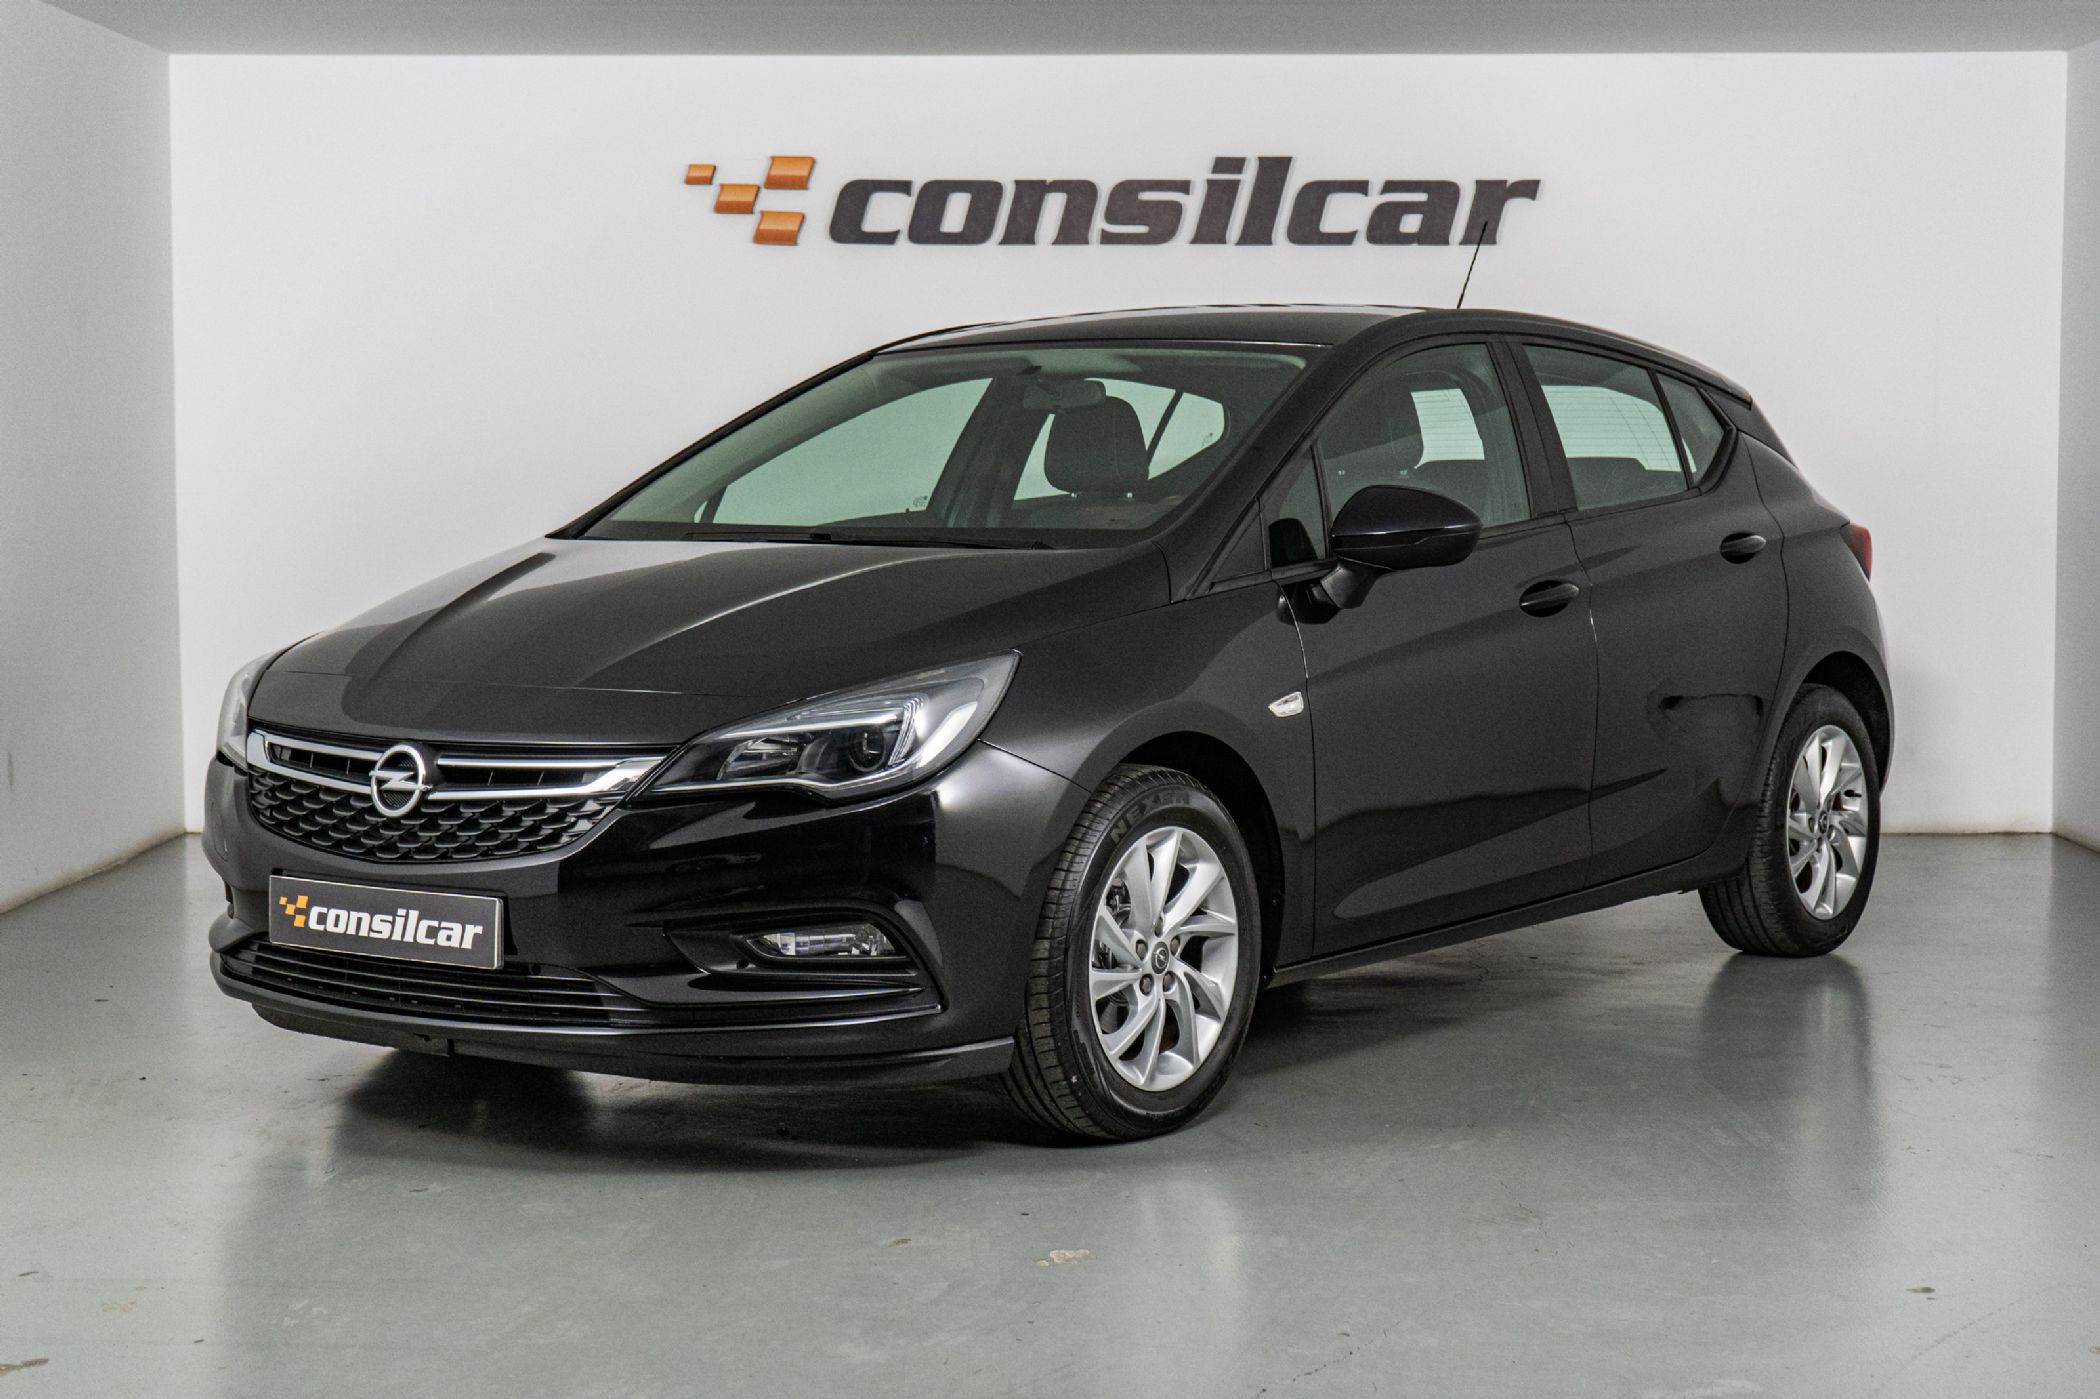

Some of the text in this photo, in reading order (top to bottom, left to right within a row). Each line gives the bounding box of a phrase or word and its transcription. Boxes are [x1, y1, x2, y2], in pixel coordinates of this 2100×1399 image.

[829, 156, 1541, 245] consilcar
[1110, 789, 1191, 843] NEXEN
[308, 906, 484, 950] consilcar
